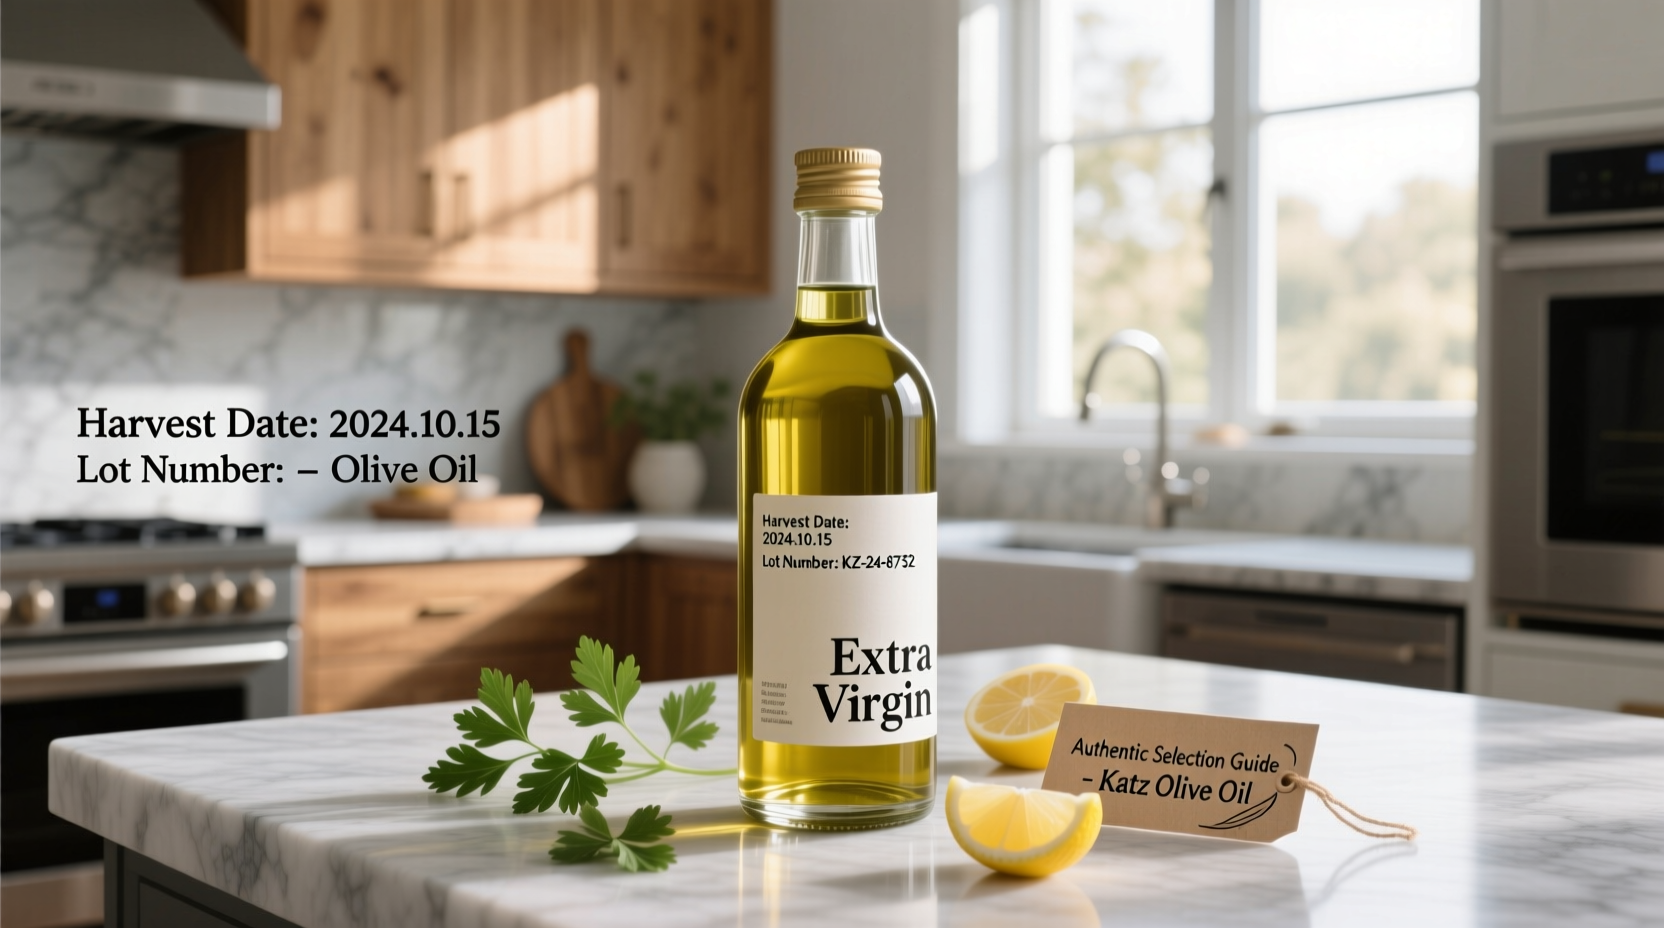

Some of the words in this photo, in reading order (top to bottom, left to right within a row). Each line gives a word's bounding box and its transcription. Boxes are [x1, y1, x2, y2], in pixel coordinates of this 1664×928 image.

[762, 514, 810, 529] Harvest
[813, 515, 849, 529] Date:
[762, 531, 833, 546] 2024.10.15
[762, 554, 780, 568] Lot
[782, 554, 839, 569] Number:
[830, 637, 932, 676] Extra
[813, 680, 932, 732] Virgin
[1071, 737, 1149, 762] Authentic
[1152, 745, 1225, 769] Selection
[1230, 752, 1280, 773] Guide
[1098, 769, 1150, 796] Katz
[1155, 774, 1213, 801] Olive
[1218, 780, 1253, 804] Oil
